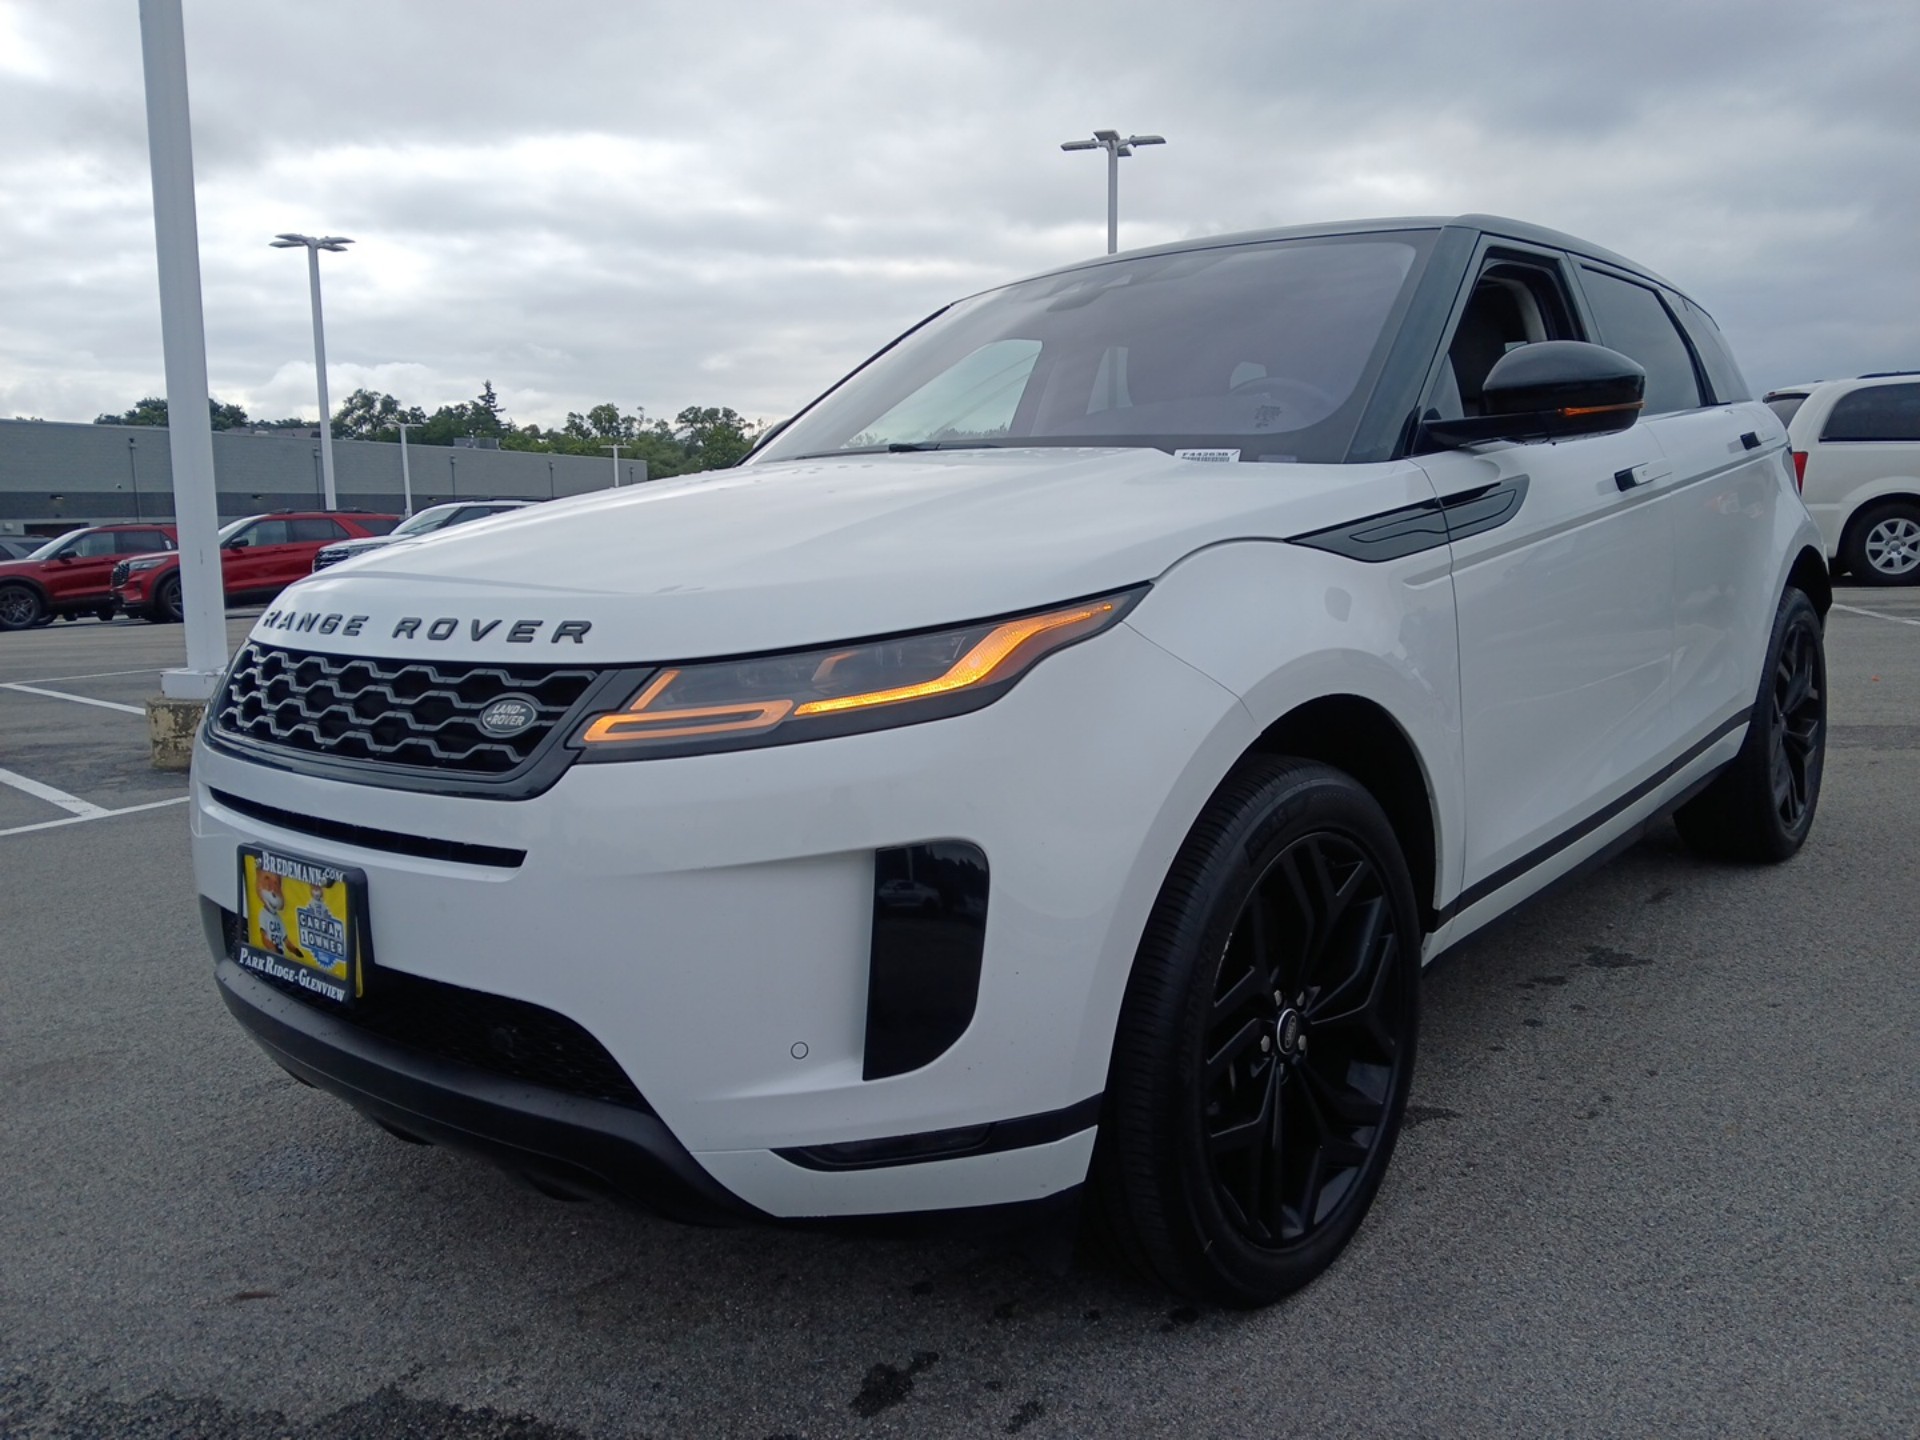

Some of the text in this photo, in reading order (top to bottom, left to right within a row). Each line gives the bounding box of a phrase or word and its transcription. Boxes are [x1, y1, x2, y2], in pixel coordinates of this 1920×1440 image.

[263, 610, 592, 644] RANGE ROVER
[492, 704, 521, 714] LAND
[490, 715, 525, 725] ROVER
[300, 913, 343, 941] CARFAX
